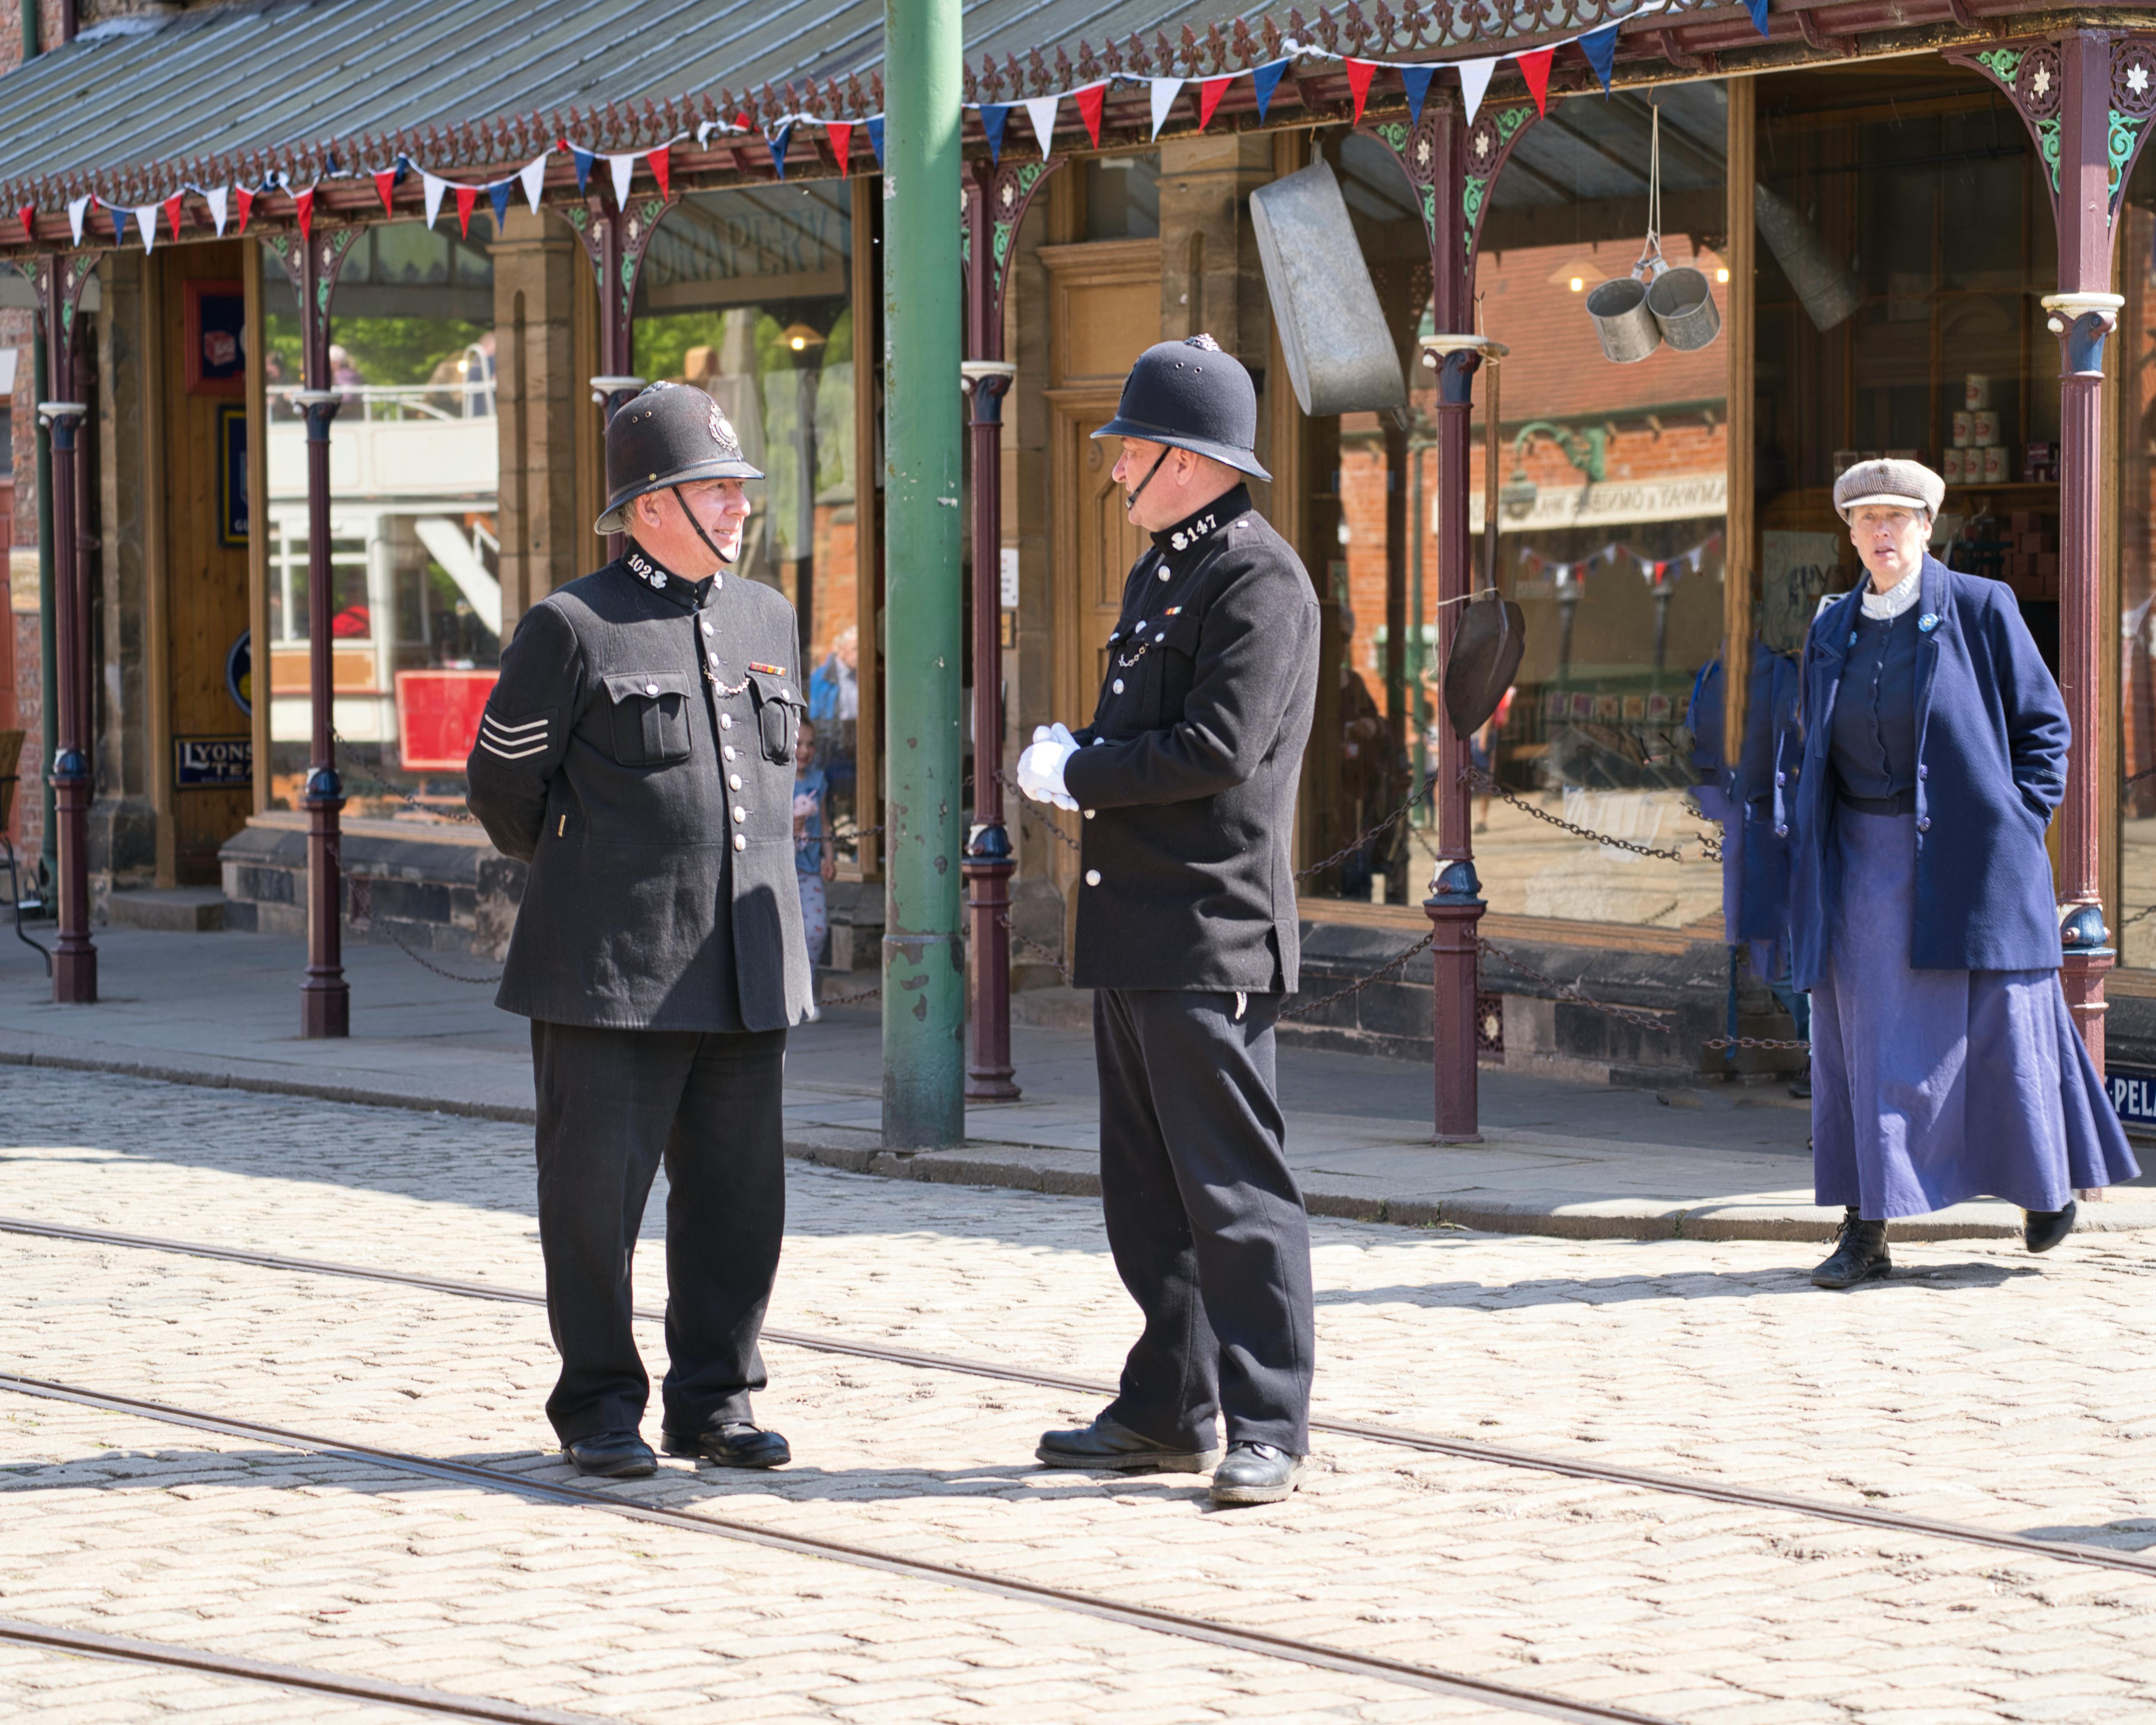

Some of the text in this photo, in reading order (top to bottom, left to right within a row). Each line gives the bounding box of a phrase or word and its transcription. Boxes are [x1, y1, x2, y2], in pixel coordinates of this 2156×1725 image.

[647, 209, 829, 286] DRAPERY
[1187, 514, 1217, 542] 147
[627, 553, 652, 580] 102
[2114, 1078, 2156, 1118] PEL
